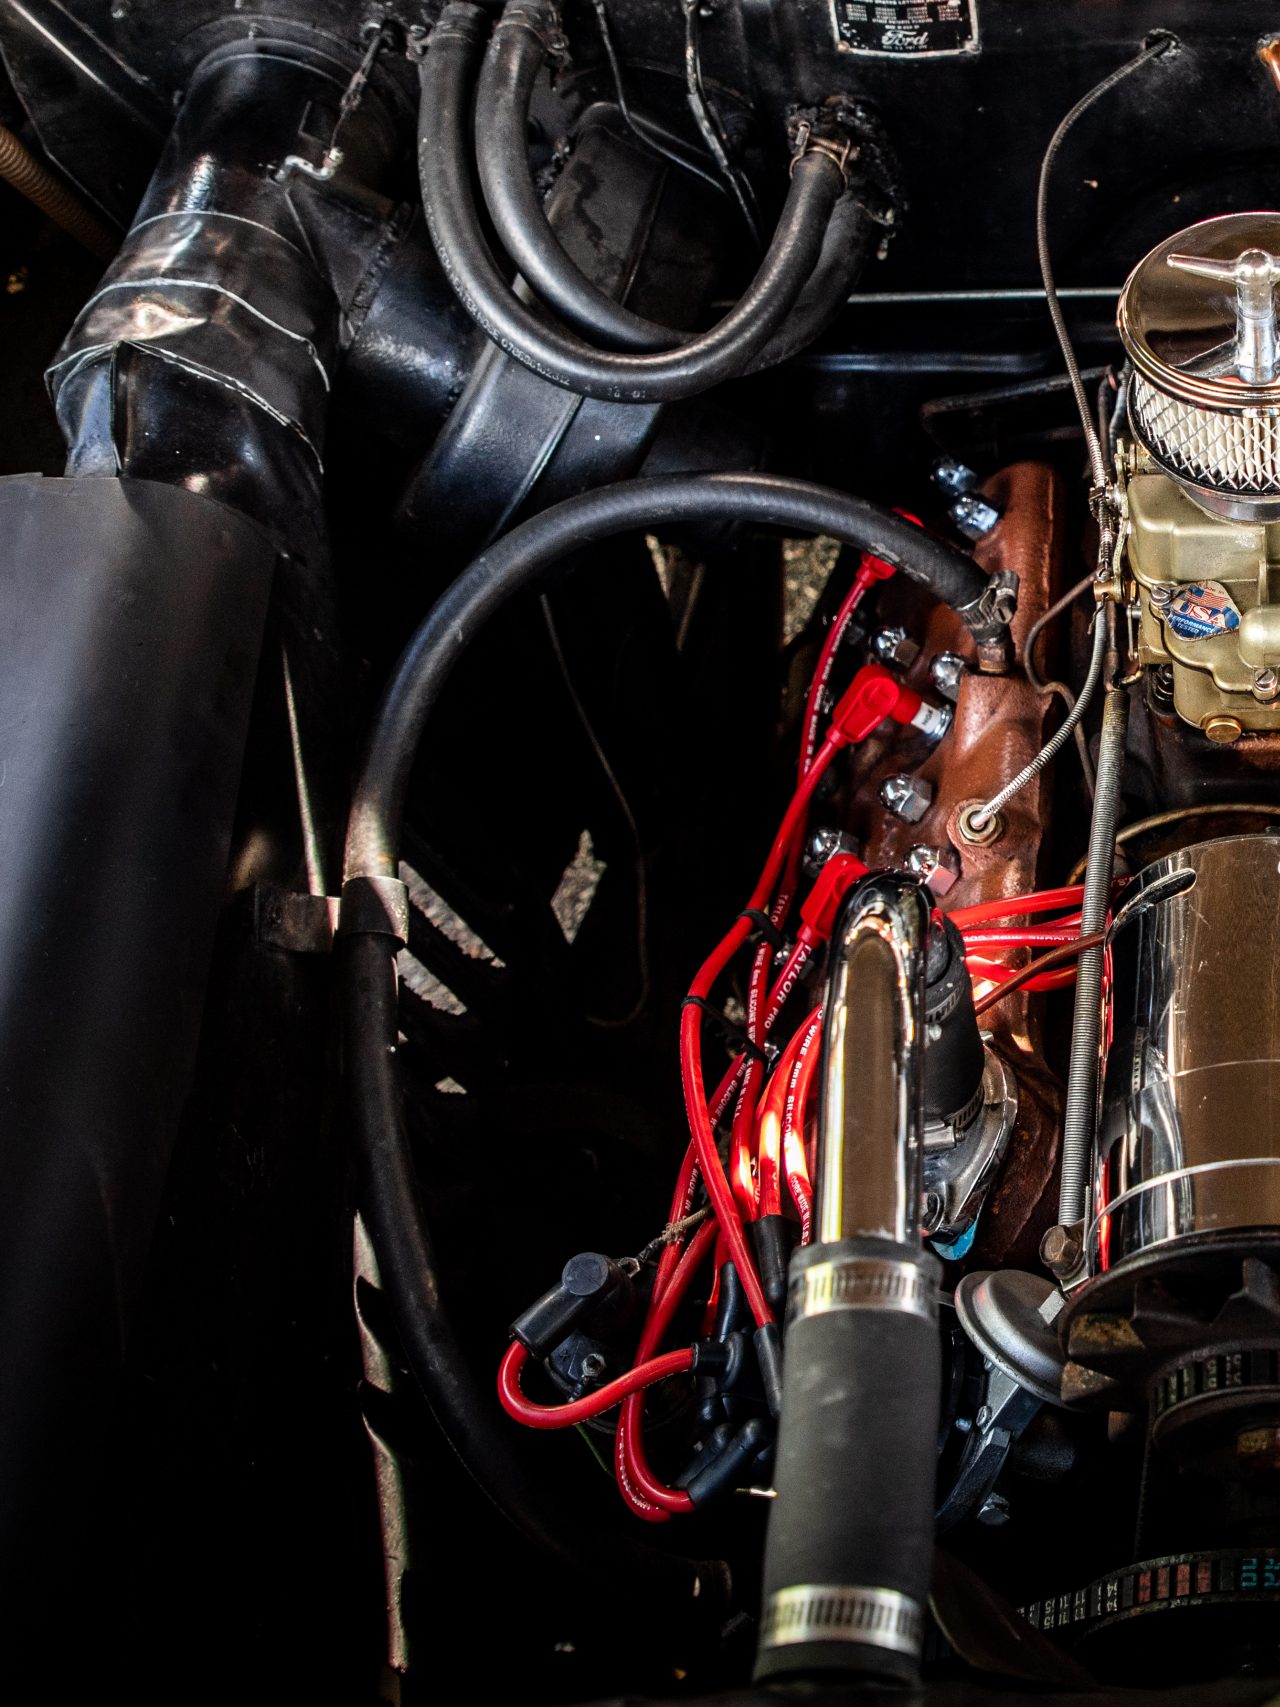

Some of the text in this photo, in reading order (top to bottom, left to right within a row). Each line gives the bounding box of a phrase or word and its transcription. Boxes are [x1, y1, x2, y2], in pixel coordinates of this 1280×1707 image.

[881, 29, 929, 46] Ford
[1169, 614, 1216, 634] PERFORMANCE
[1172, 598, 1227, 630] USA
[1176, 622, 1200, 635] TESTED
[770, 894, 789, 926] TAYLO
[763, 943, 813, 1030] TAYLOR PRO
[747, 988, 760, 1023] SILICONE
[747, 1025, 757, 1045] WIR
[783, 1025, 818, 1142] WIRE 8mm SILICO
[714, 1079, 739, 1119] SILICONE
[686, 1168, 699, 1195] MADE
[790, 1175, 802, 1194] CORE
[684, 1199, 693, 1213] IN
